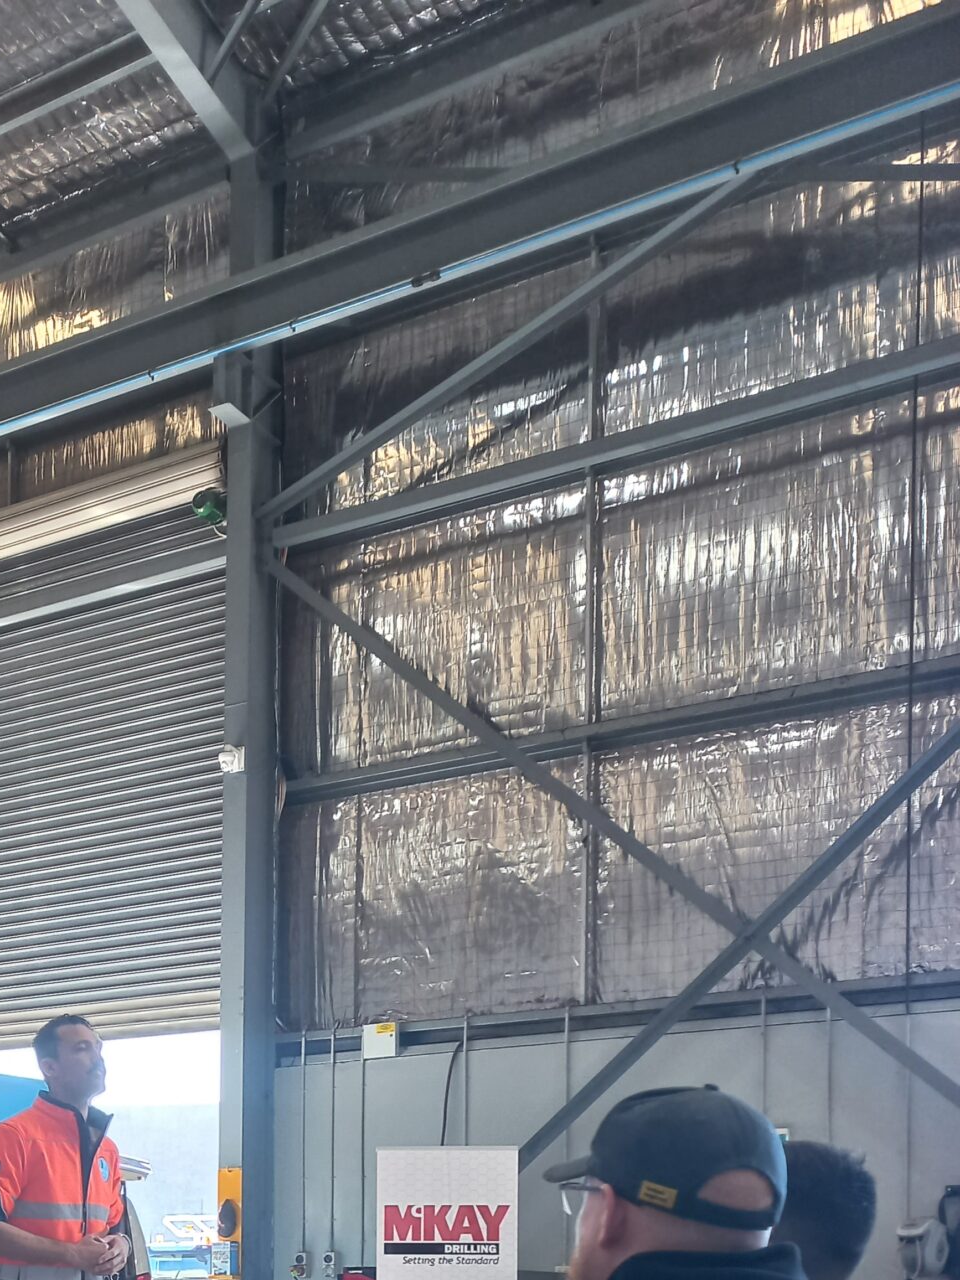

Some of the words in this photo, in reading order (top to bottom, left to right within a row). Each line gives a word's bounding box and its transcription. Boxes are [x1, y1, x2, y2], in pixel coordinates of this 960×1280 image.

[444, 1244, 497, 1254] DRILLING
[402, 1256, 435, 1266] Setting
[438, 1256, 454, 1264] the
[456, 1256, 500, 1264] Standard
